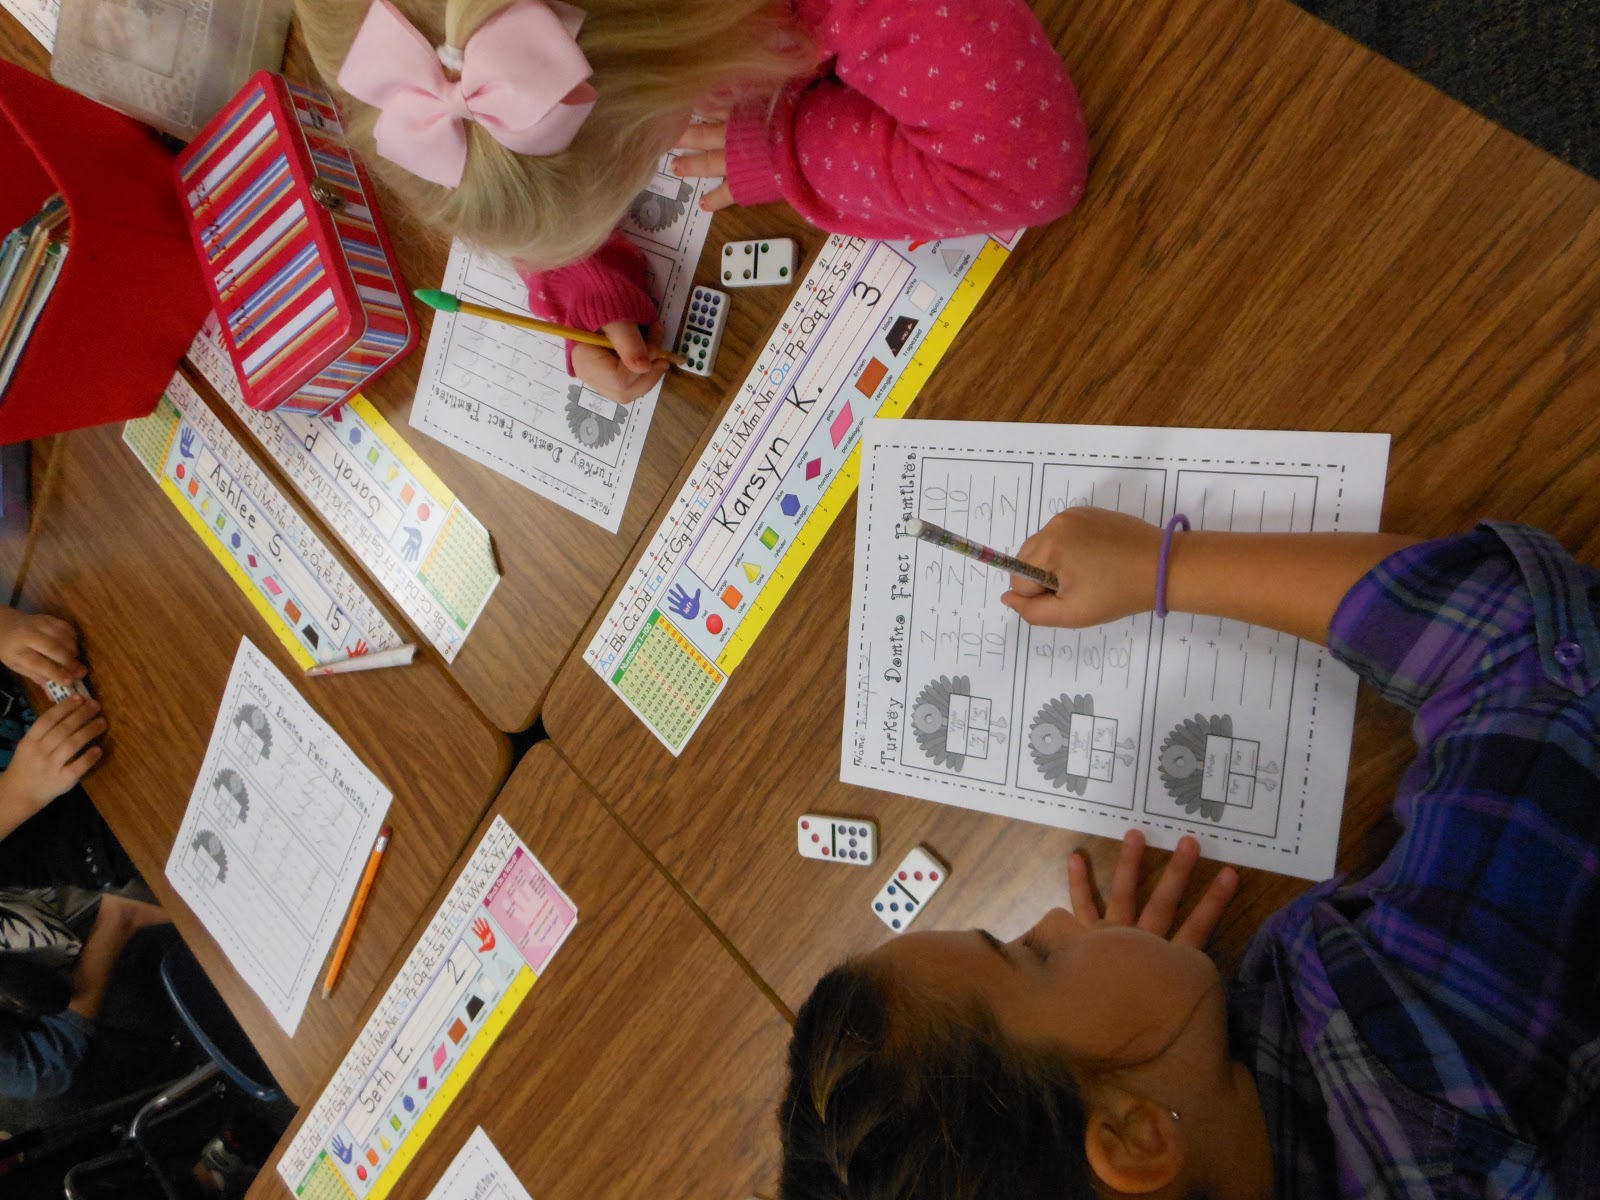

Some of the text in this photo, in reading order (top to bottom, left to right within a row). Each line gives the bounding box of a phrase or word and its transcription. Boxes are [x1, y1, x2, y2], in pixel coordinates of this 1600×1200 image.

[832, 261, 852, 281] Ss
[816, 285, 836, 308] Rr
[800, 308, 830, 334] Qq
[690, 479, 697, 487] 10
[702, 461, 708, 469] 11
[712, 442, 719, 450] 12
[723, 423, 730, 431] 13
[734, 404, 742, 412] 14
[746, 384, 753, 393] 15
[758, 364, 765, 372] 16
[769, 344, 777, 352] 17
[782, 323, 789, 332] 18
[793, 301, 801, 311] 19
[805, 279, 814, 290] 20
[819, 258, 826, 268] 21
[831, 235, 839, 246] 22
[785, 339, 807, 361] Pp
[770, 362, 791, 386] Oo
[713, 281, 881, 534] Karsyn K. 3
[754, 389, 776, 412] Nn
[487, 412, 514, 439] Fact
[716, 579, 728, 596] orange
[734, 552, 745, 568] yellow
[754, 521, 764, 536] green
[775, 490, 784, 501] blue
[796, 451, 808, 468] purple
[825, 409, 835, 422] pink
[853, 358, 866, 377] brown
[882, 316, 894, 331] black
[904, 278, 917, 295] white
[736, 413, 760, 442] Mm
[522, 429, 563, 463] Domino
[719, 626, 731, 643] sphere
[738, 602, 747, 614] cube
[756, 574, 765, 586] cone
[774, 539, 787, 558] cylinder
[794, 504, 810, 527] hexagon
[817, 468, 834, 491] rhombus
[874, 374, 893, 401] rectangle
[902, 328, 922, 357] trapezoid
[929, 296, 944, 317] square
[953, 254, 971, 278] triangle
[726, 436, 742, 460] Ll
[305, 422, 381, 519] Sarah P.
[713, 460, 733, 480] Kk
[704, 479, 724, 498] Jj
[695, 498, 709, 513] Ii
[949, 490, 969, 512] 10
[683, 510, 701, 532] Hh
[210, 463, 343, 631] Ashlee S. 15
[670, 532, 692, 554] Gg
[658, 552, 674, 574] Ff
[921, 487, 947, 643] 7 3 10
[646, 574, 663, 592] Ee
[891, 554, 911, 600] Fact
[962, 633, 982, 656] 10
[975, 502, 992, 520] 3
[634, 589, 652, 613] Dd
[623, 615, 640, 632] Cc
[610, 634, 626, 652] Bb
[620, 623, 653, 672] Numbers 1-100
[884, 614, 906, 683] Domino
[941, 632, 960, 644] 3
[985, 633, 1005, 655] 10
[1036, 643, 1054, 657] 5
[600, 653, 615, 673] Aa
[1108, 647, 1128, 668] 8
[854, 735, 865, 766] Name:
[1206, 753, 1216, 777] Whole
[467, 880, 486, 900] Ww
[482, 863, 496, 879] Xx
[491, 847, 508, 861] Yy
[500, 833, 516, 849] Zz
[359, 960, 465, 1114] Seth E. 2
